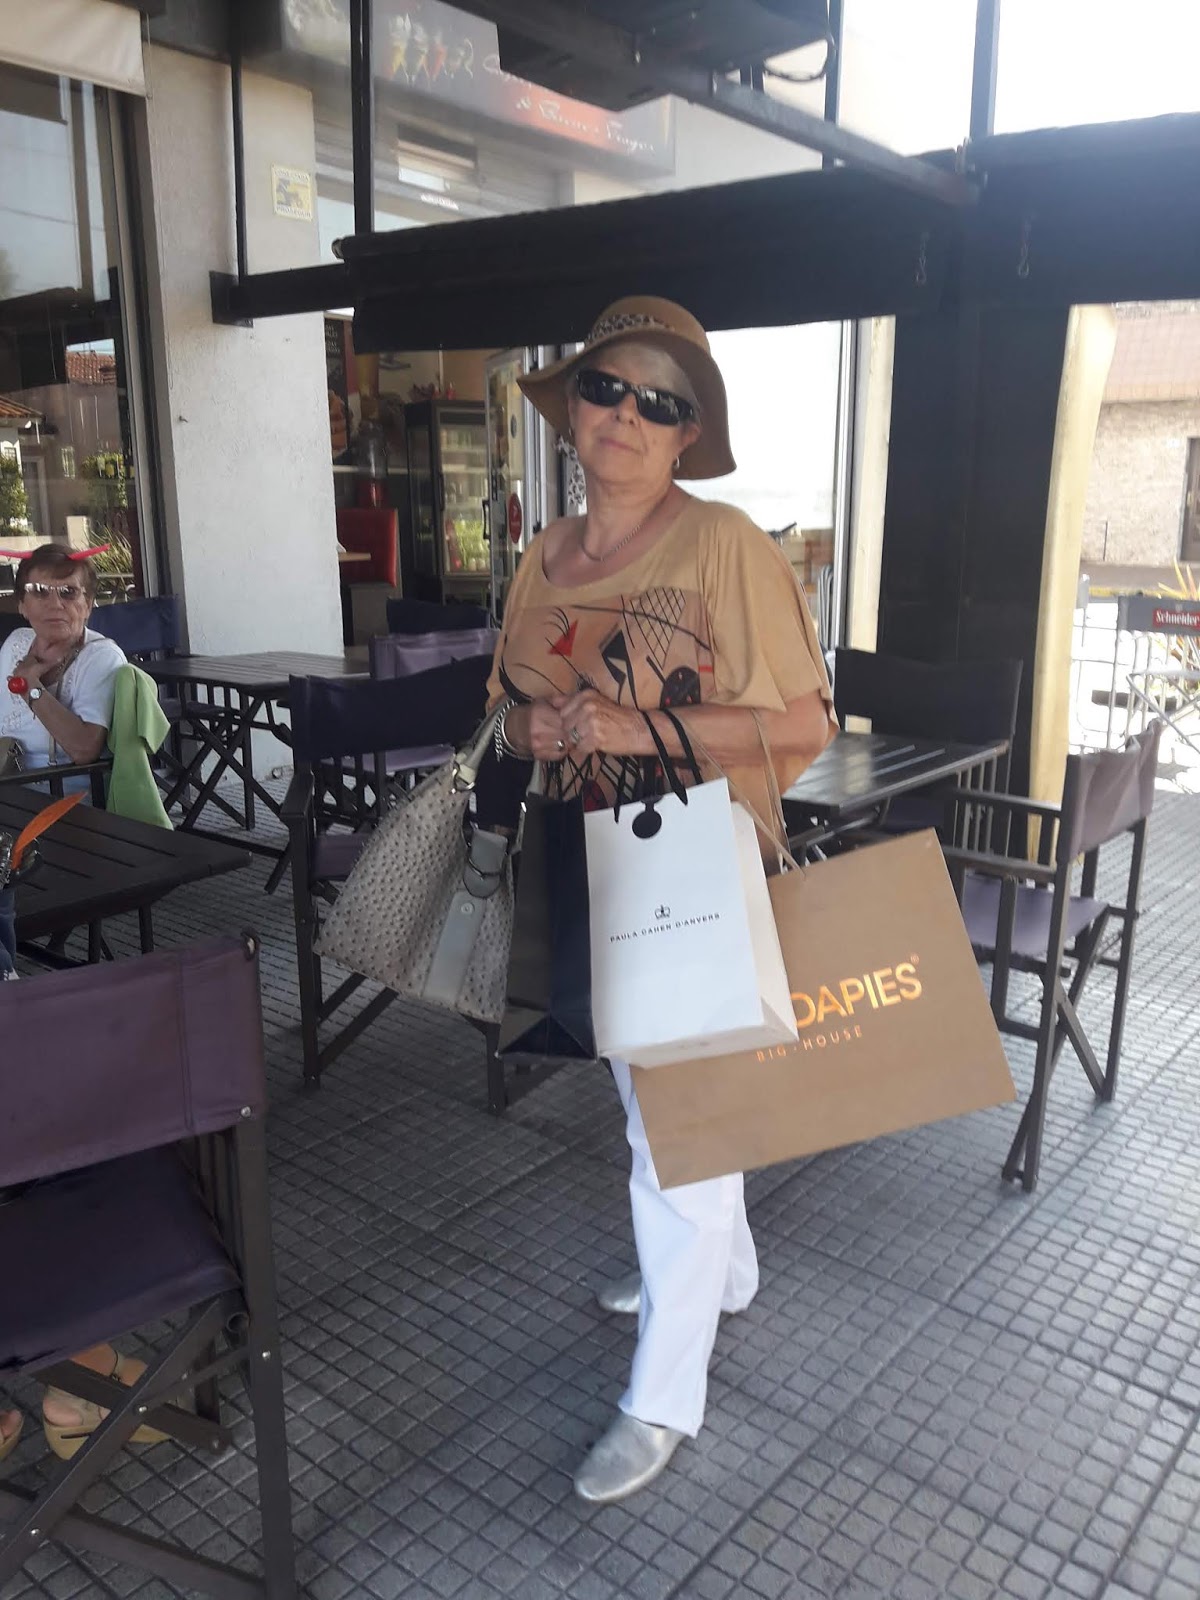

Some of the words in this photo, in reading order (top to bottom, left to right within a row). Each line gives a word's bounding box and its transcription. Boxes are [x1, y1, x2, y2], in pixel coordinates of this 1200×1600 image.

[1156, 610, 1200, 626] Schneider
[610, 931, 638, 943] PAULA
[641, 924, 672, 936] CAHEN
[675, 912, 720, 928] D'ANVERS
[756, 1044, 787, 1063] BIG
[803, 1025, 863, 1051] HOUSE
